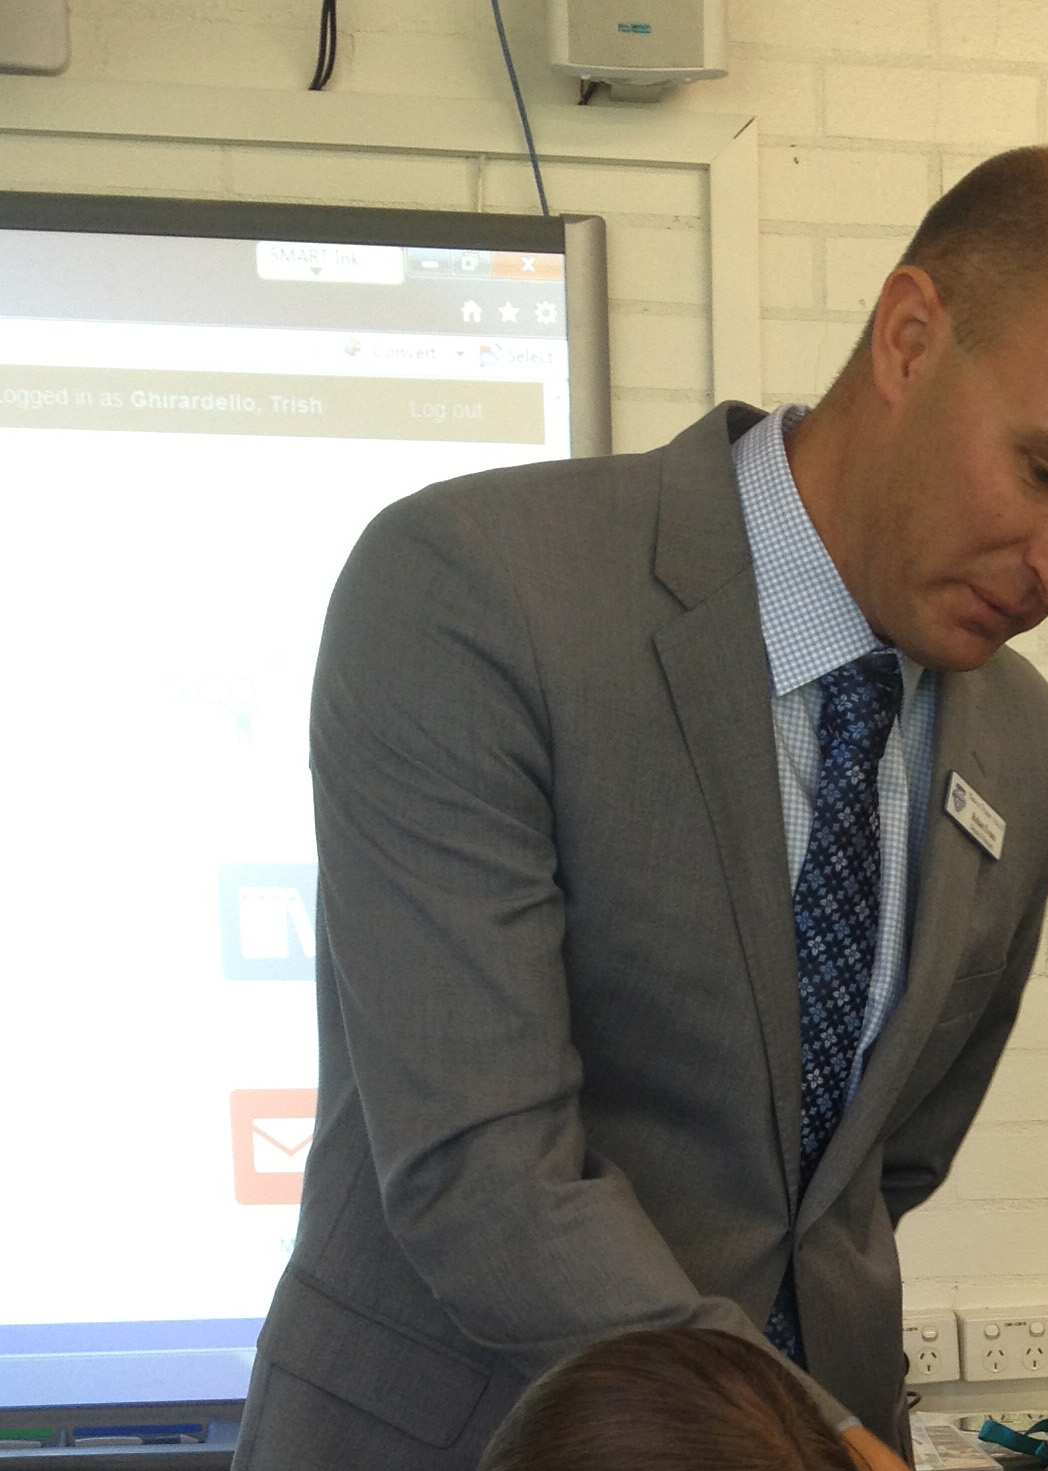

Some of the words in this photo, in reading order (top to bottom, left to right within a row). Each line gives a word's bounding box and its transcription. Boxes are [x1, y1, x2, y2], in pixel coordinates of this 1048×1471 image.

[73, 388, 93, 408] in
[100, 391, 124, 409] as
[271, 395, 323, 416] Trish
[409, 400, 447, 423] Log
[450, 402, 483, 421] out
